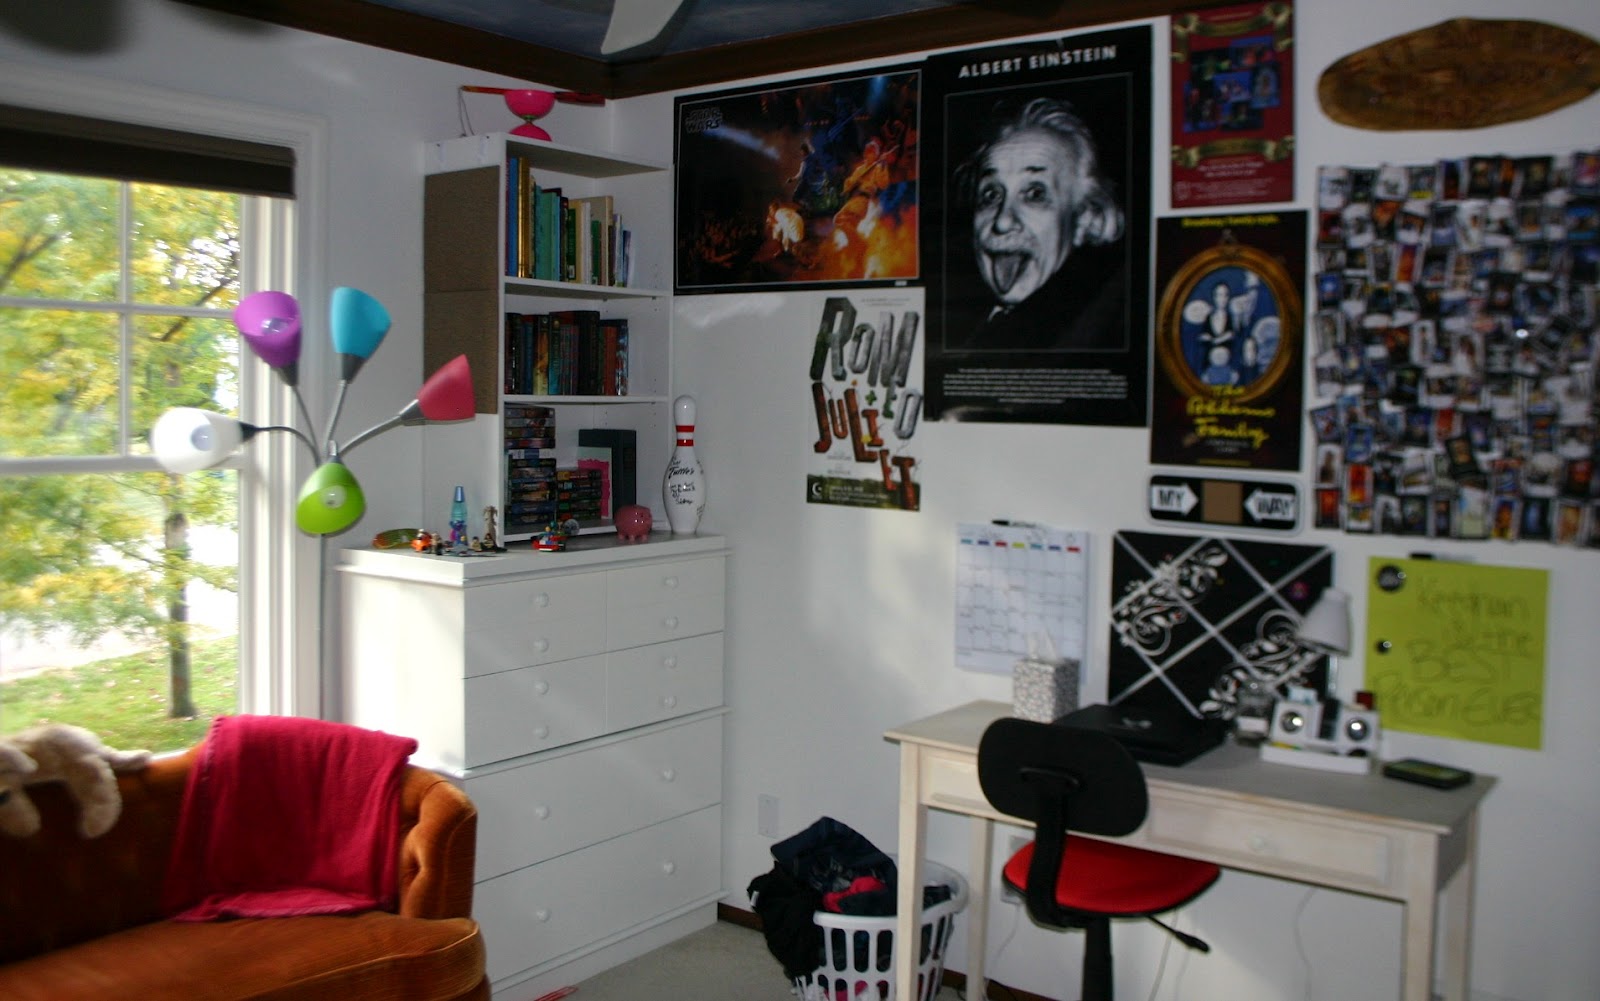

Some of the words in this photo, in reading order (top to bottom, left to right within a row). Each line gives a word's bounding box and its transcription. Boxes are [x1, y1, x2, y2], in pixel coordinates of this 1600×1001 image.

[958, 57, 1022, 78] ALBERT
[1029, 45, 1117, 70] EINSTEIN
[685, 117, 722, 133] WARS
[1159, 489, 1185, 507] MY
